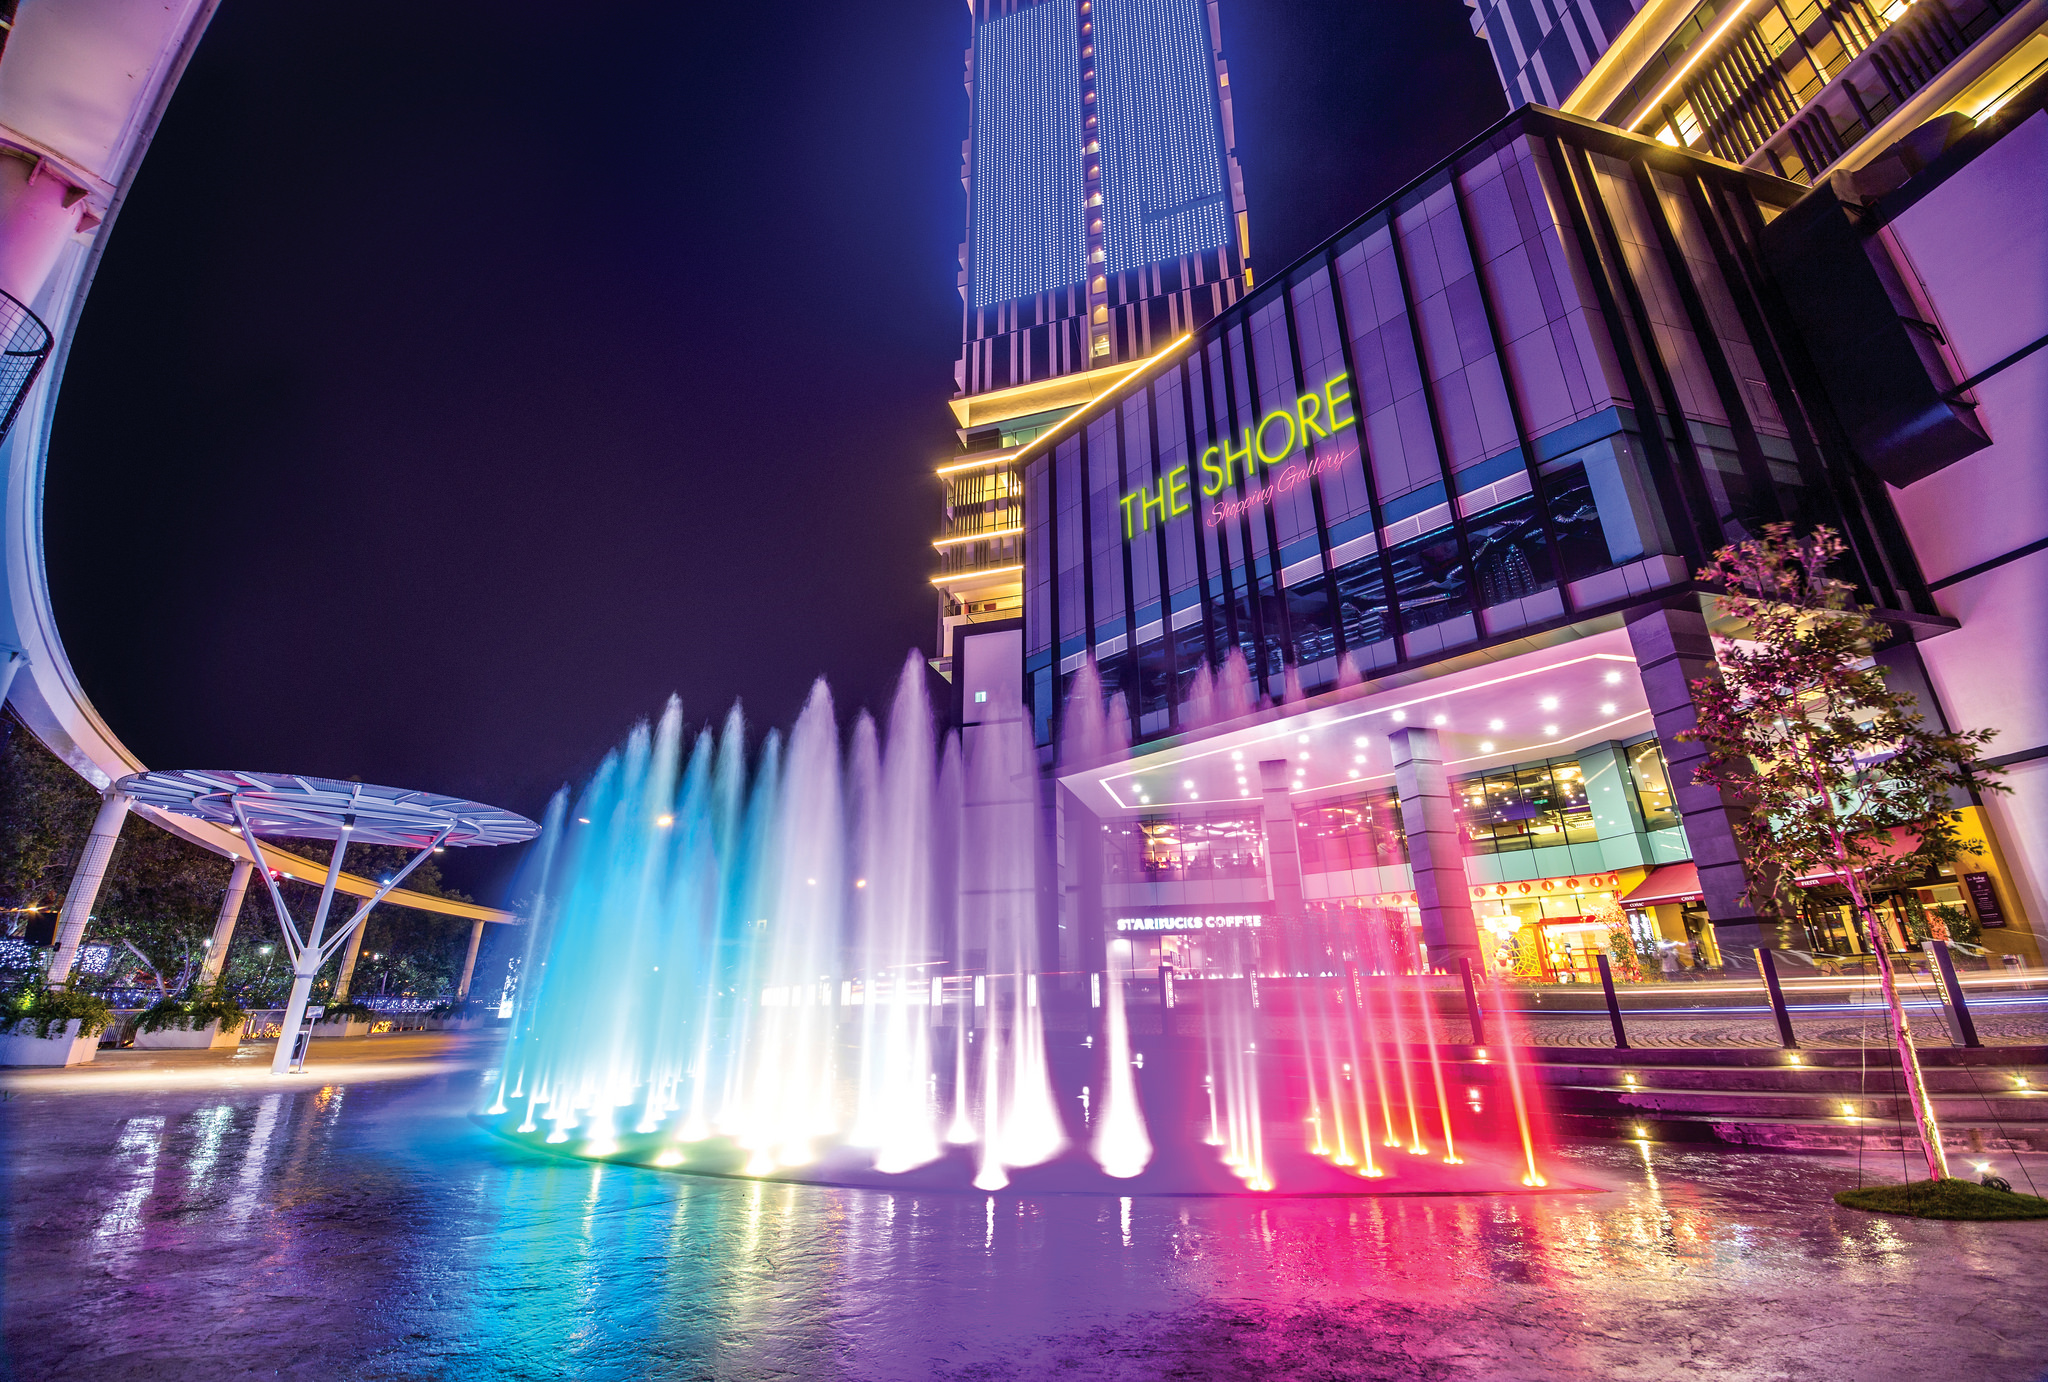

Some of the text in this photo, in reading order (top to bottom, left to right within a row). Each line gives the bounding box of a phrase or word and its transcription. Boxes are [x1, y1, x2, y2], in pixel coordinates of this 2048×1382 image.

[1119, 371, 1356, 540] THE SHORE
[1206, 443, 1361, 528] Shopping Gallery
[1116, 915, 1262, 931] STARBUCKS COFFEE
